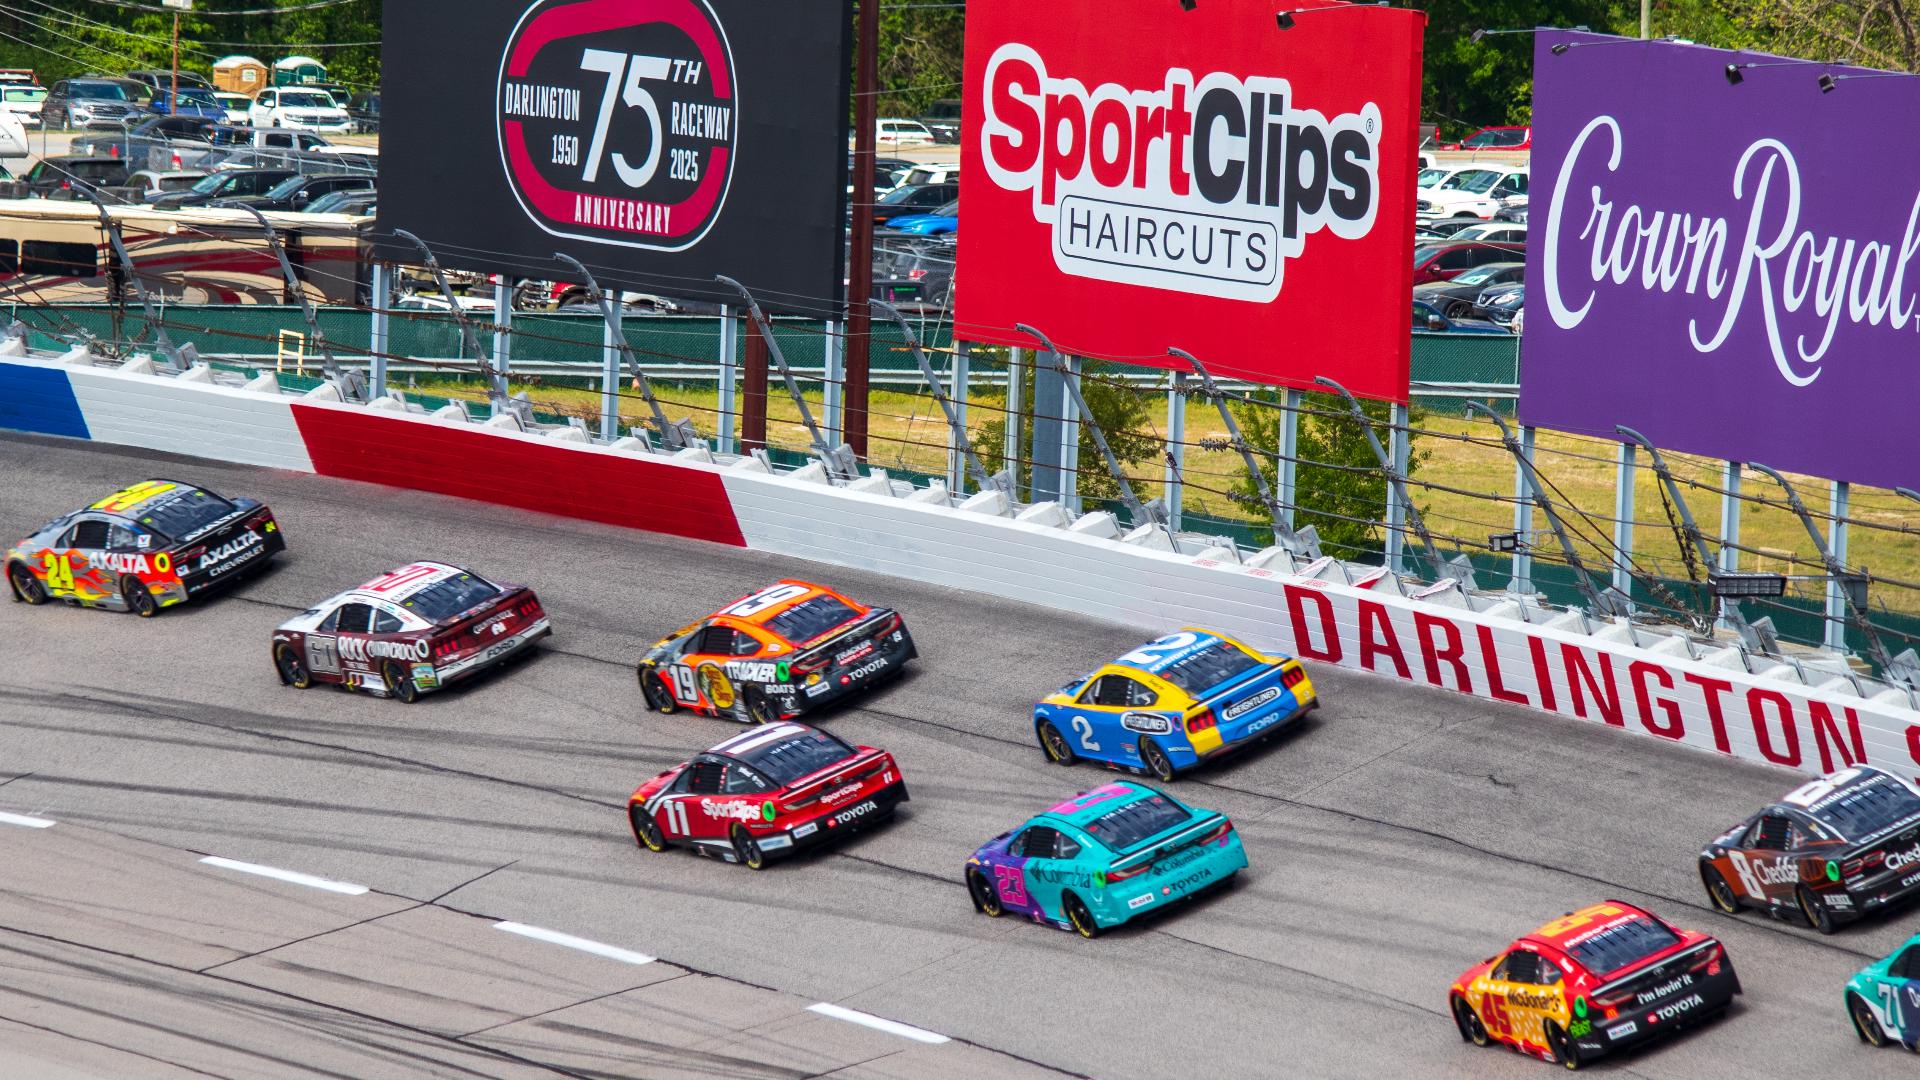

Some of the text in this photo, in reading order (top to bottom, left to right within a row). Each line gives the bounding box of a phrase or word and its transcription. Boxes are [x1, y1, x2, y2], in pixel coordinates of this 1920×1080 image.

[505, 83, 580, 121] DARLINGTON
[671, 101, 730, 141] RACEWAY
[552, 135, 579, 166] 1950
[670, 148, 699, 182] 2025
[988, 58, 1371, 239] SportClips
[574, 195, 671, 234] ANNIVERSARY
[1069, 207, 1268, 272] HAIRCUTS
[1544, 115, 1920, 387] Crown Royal
[88, 552, 152, 575] AXALTA
[200, 530, 263, 569] AXALTA
[209, 544, 265, 577] CHEVROLET
[44, 553, 75, 591] 24
[338, 636, 370, 662] ROCK
[487, 640, 516, 658] FORD
[669, 664, 699, 702] 19
[725, 661, 777, 683] TRACKER
[848, 657, 888, 681] TOYOTA
[1283, 584, 1868, 774] DARLINGTON
[765, 684, 796, 694] BOATS
[1228, 689, 1277, 718] FREIGHTLINER
[1072, 715, 1100, 752] 2
[1247, 712, 1279, 734] FORD
[820, 782, 864, 804] SportClips
[663, 799, 691, 836] 11
[701, 797, 761, 823] SportClips
[835, 801, 878, 824] TOYOTA
[1161, 849, 1216, 873] Columbia
[1728, 850, 1767, 901] 8
[994, 864, 1029, 907] 23
[1170, 868, 1213, 891] TOYOTA
[1637, 973, 1693, 1005] I'm lovin' it
[1878, 982, 1906, 1029] 71
[1481, 991, 1513, 1036] 45
[1656, 993, 1704, 1020] TOYOTA
